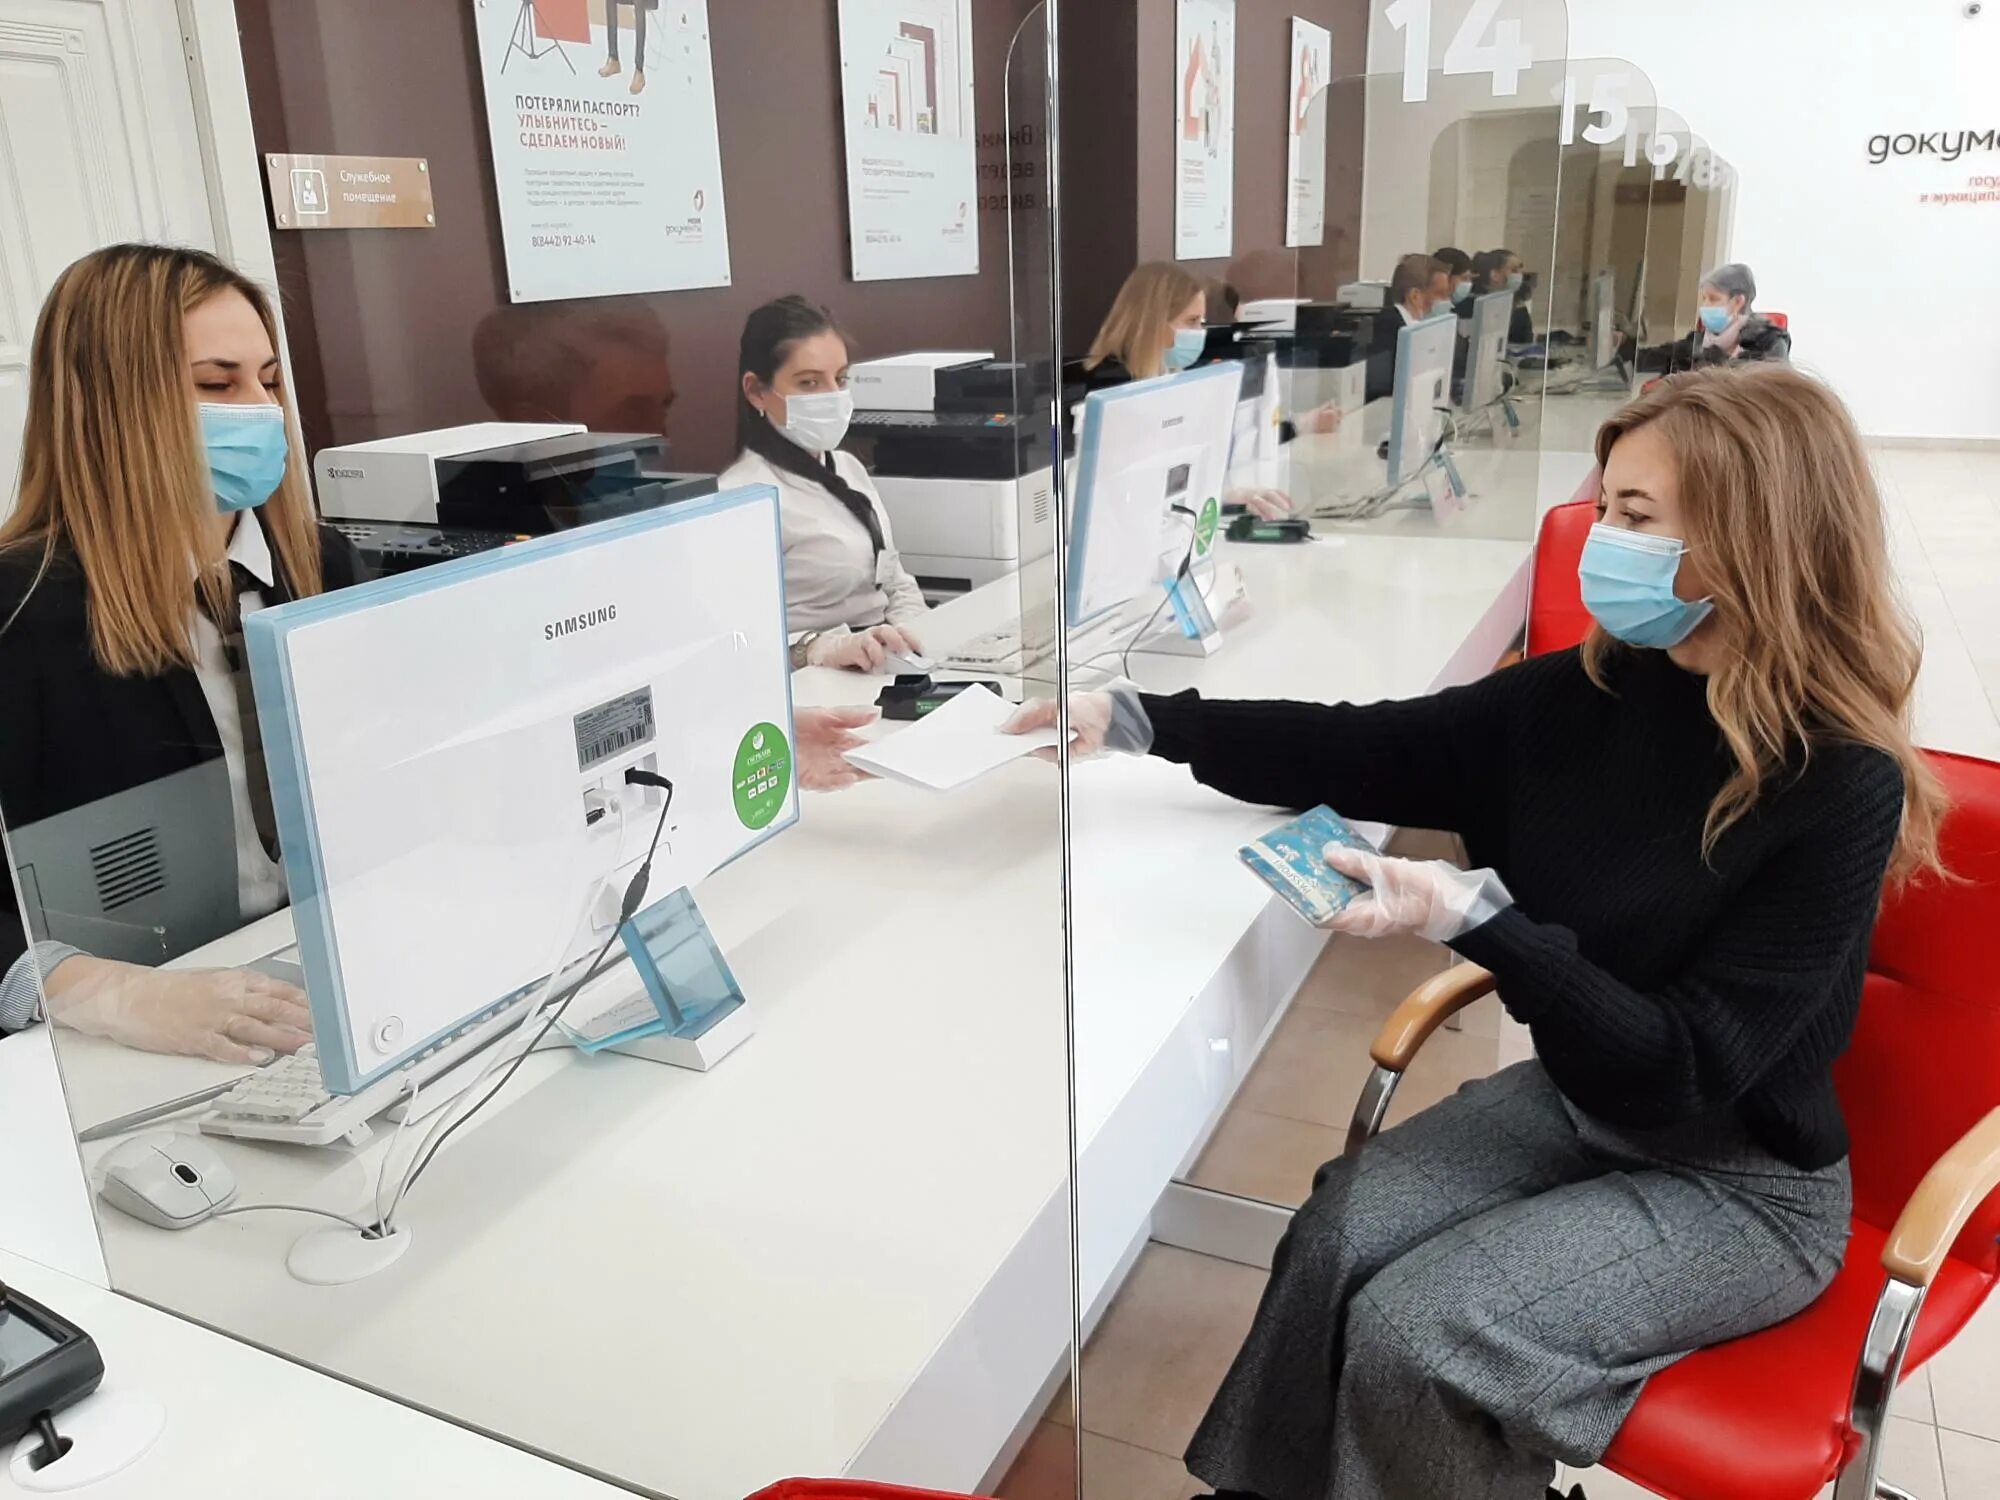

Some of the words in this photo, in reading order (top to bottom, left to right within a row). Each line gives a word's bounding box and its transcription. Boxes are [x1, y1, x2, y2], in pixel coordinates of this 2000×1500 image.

[1384, 0, 1533, 103] 14
[515, 95, 581, 113] ПОТЕРЯЛИ
[583, 100, 640, 117] ПАСПОРТ?
[1551, 73, 1632, 146] 15
[518, 114, 598, 132] УЛЫБНИТЕСЬ
[520, 132, 578, 149] СДЕЛАЕМ
[581, 135, 626, 151] НОВЫЙ!
[1868, 129, 2000, 164] докум
[340, 170, 391, 185] Служебное
[343, 192, 396, 204] помещение
[544, 604, 616, 641] SAMSUNG
